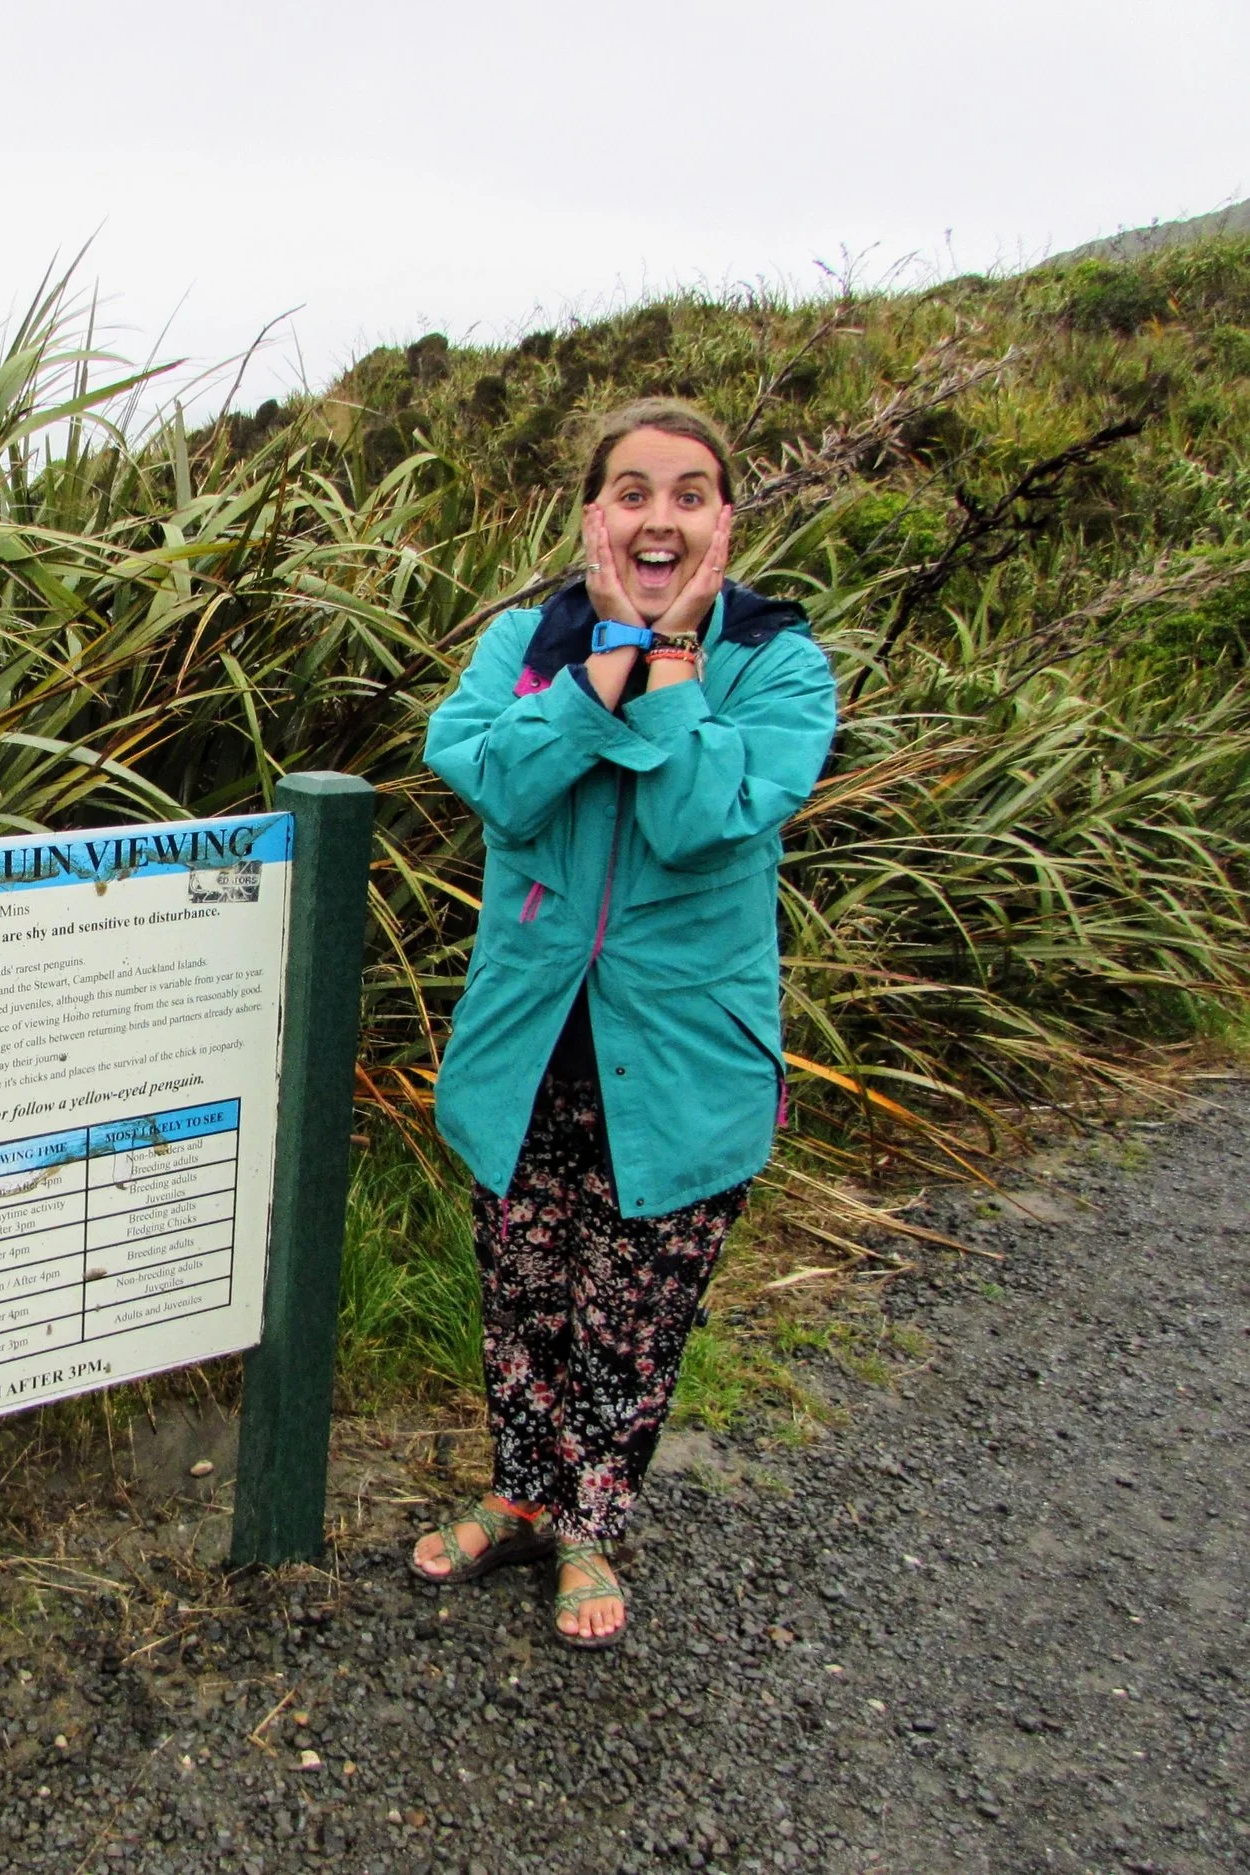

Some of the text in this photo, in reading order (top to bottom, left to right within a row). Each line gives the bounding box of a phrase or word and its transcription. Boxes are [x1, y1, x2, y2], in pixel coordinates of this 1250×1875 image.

[84, 826, 255, 872] VIEWING
[0, 903, 29, 917] Mins
[1, 931, 22, 942] are
[25, 926, 47, 941] shy
[51, 921, 74, 936] and
[78, 916, 130, 933] sensitive
[133, 915, 145, 926] to
[148, 907, 220, 924] disturbance.
[15, 963, 40, 973] rarest
[43, 958, 85, 972] penguins.
[9, 1100, 55, 1122] follow
[58, 1099, 66, 1109] a
[68, 1080, 147, 1111] yellow-eyed
[147, 1072, 204, 1097] penguin.
[185, 1114, 201, 1128] TO
[202, 1110, 224, 1125] SEE
[35, 1141, 68, 1158] TIME
[186, 1138, 203, 1151] and
[130, 1154, 198, 1177] Breeding adults
[41, 1173, 62, 1189] 4pm
[129, 1172, 197, 1194] Breeding adults
[145, 1188, 185, 1204] Juveniles
[30, 1201, 64, 1214] activity
[129, 1201, 196, 1223] Breeding adults
[15, 1220, 35, 1232] 3pm
[126, 1214, 196, 1236] Fledging Chicks
[9, 1246, 29, 1258] 4pm
[127, 1238, 194, 1260] Breeding adults
[13, 1275, 36, 1287] After
[39, 1270, 59, 1282] 4pm
[116, 1260, 203, 1287] Non-breeding adults
[143, 1277, 183, 1296] Juveniles
[8, 1308, 28, 1320] 4pm
[114, 1295, 201, 1323] Adults and Juveniles
[9, 1338, 28, 1350] 3pm
[6, 1369, 63, 1396] AFTER
